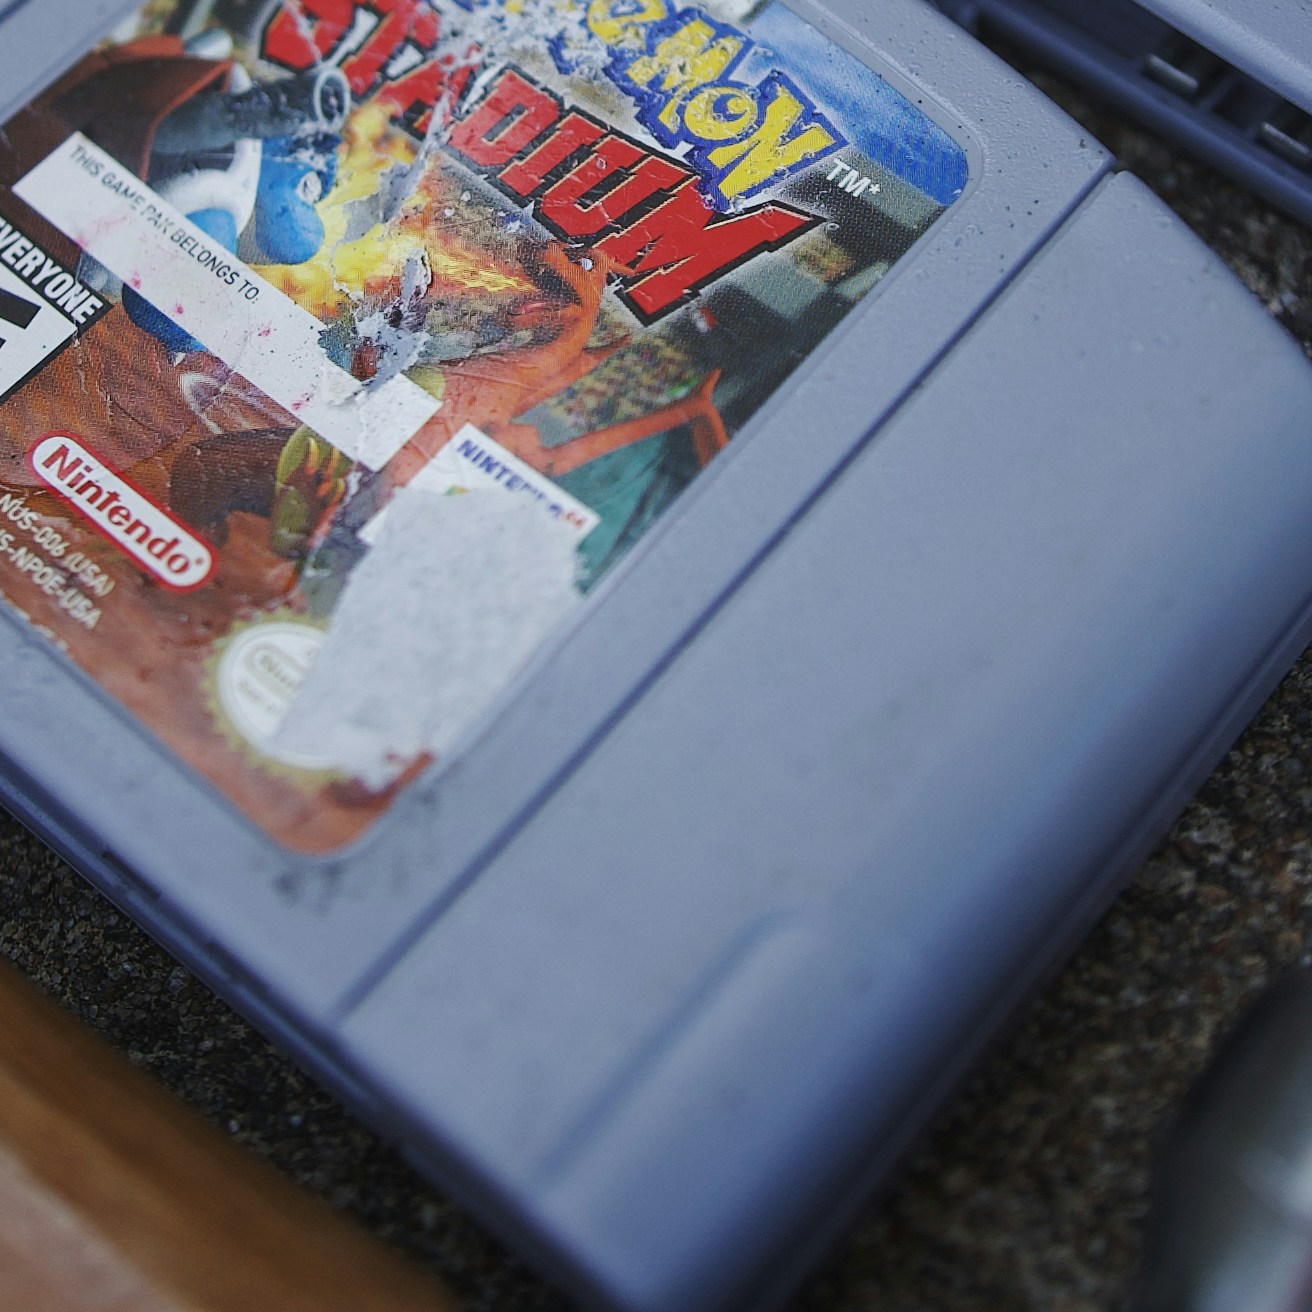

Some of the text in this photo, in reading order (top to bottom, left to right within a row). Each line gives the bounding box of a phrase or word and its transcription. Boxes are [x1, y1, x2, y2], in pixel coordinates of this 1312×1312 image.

[69, 145, 261, 305] THIS GAME PAK BELONGS TO:
[41, 443, 191, 576] Nintendo
[63, 551, 116, 598] (USA)
